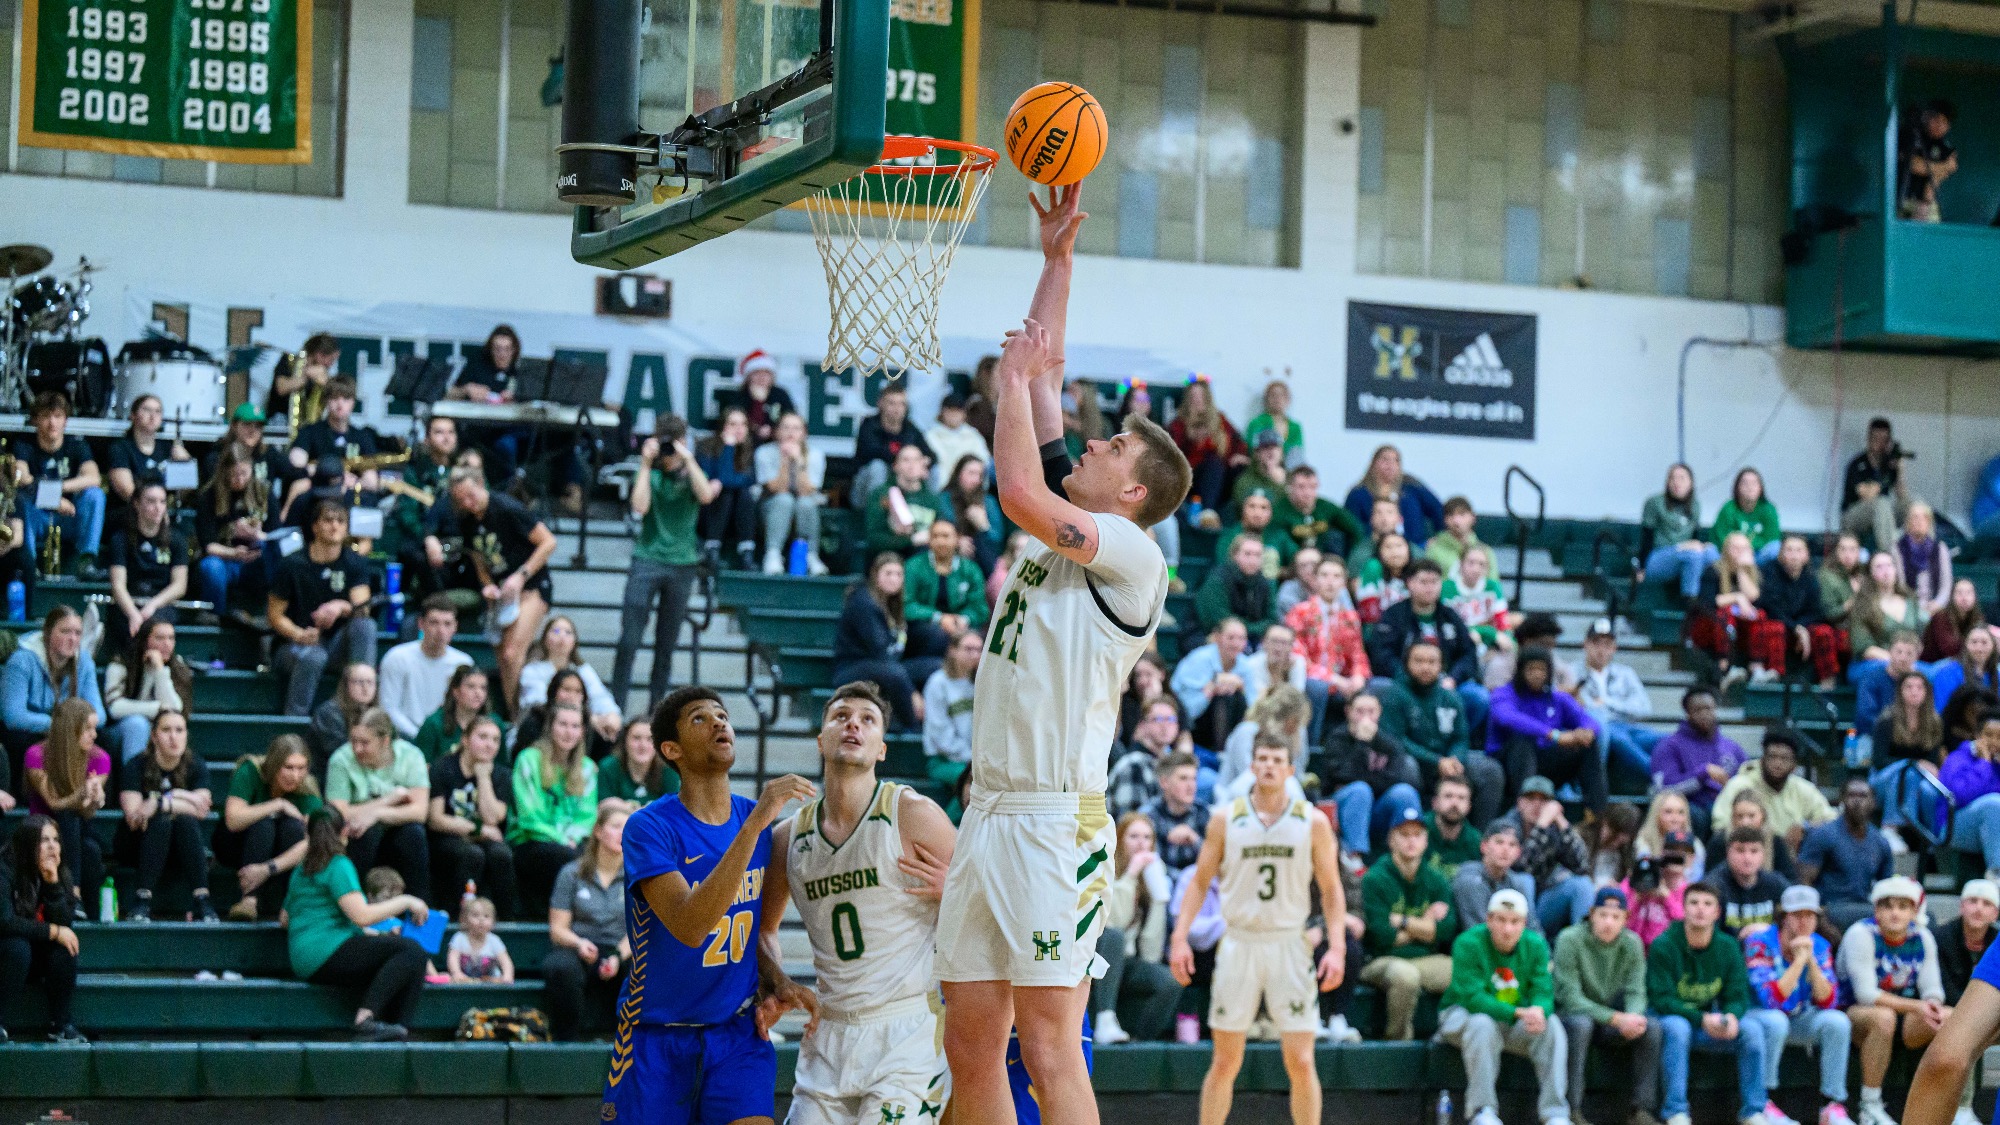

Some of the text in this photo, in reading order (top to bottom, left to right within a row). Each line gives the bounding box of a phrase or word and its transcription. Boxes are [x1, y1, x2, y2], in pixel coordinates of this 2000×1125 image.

[67, 6, 148, 44] 1993
[189, 17, 270, 54] 1995
[66, 46, 146, 84] 1997
[188, 57, 269, 95] 1998
[59, 87, 149, 126] 2002
[183, 97, 271, 134] 2004
[1027, 127, 1069, 179] Wilson
[1358, 392, 1390, 414] the
[1390, 396, 1451, 421] eagles
[804, 867, 879, 901] HUSSON
[1258, 865, 1276, 900] 3
[702, 910, 754, 967] 20
[832, 902, 864, 961] 0
